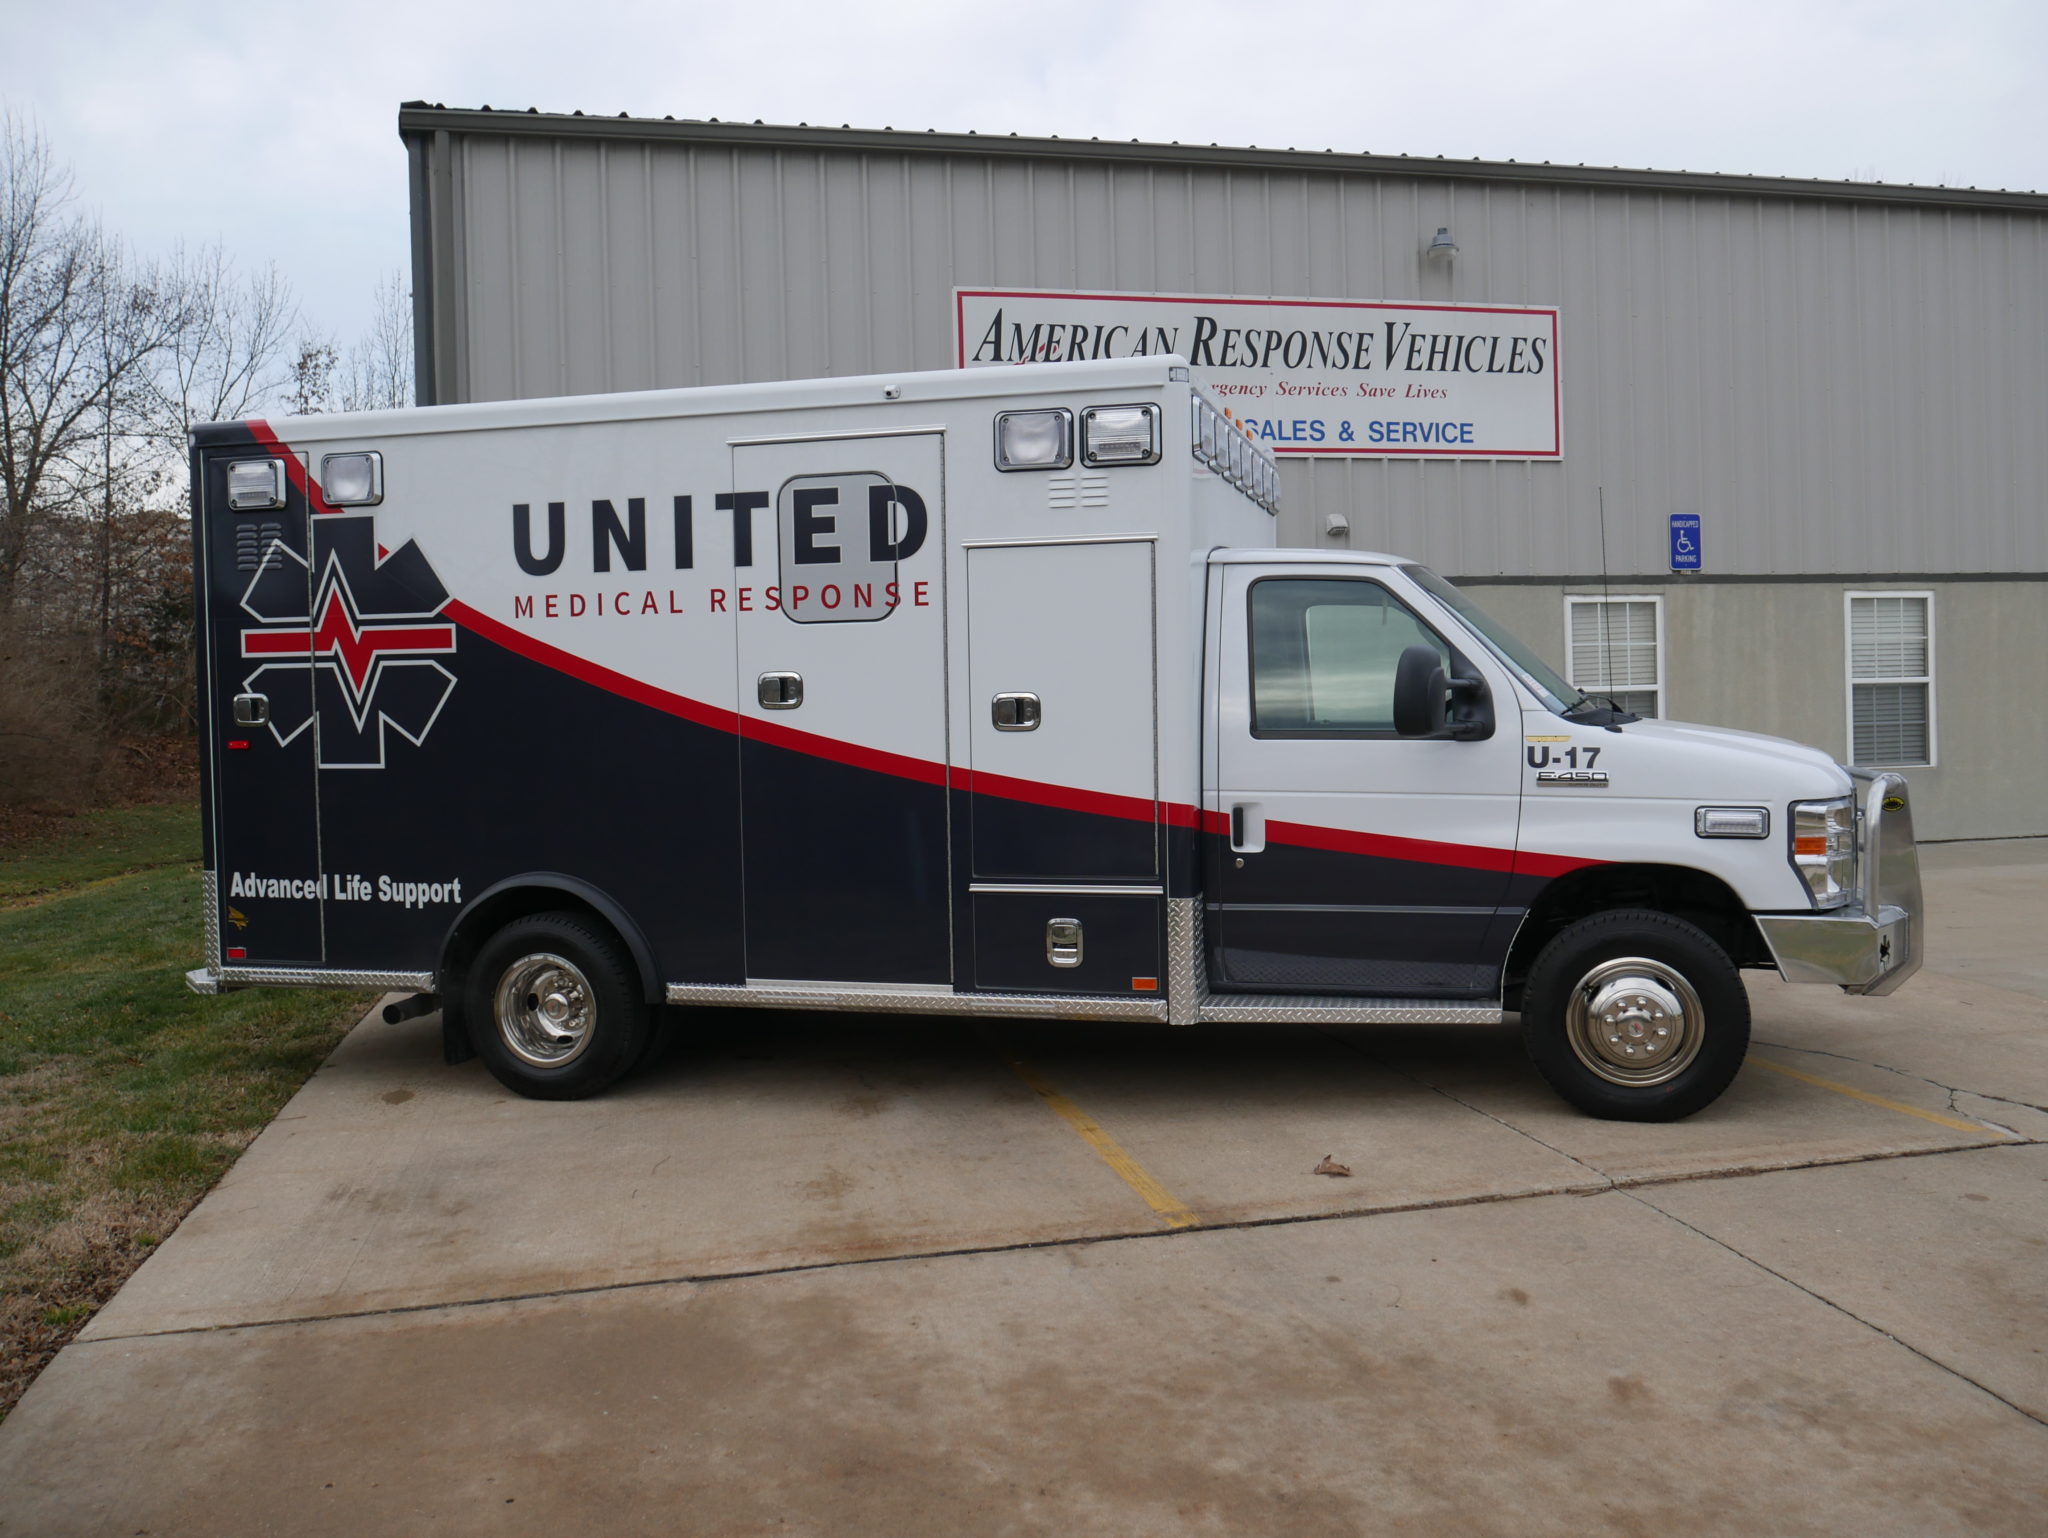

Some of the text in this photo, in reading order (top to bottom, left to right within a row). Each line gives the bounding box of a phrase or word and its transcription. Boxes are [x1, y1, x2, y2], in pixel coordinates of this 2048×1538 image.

[1190, 316, 1374, 370] RESPONSE
[1385, 321, 1547, 375] VEHICLES
[1275, 381, 1348, 397] Services
[1356, 383, 1396, 398] Save
[1405, 384, 1448, 399] Lives
[1338, 420, 1355, 441] &
[1368, 421, 1474, 443] SERVICE
[512, 484, 928, 576] UNITED
[514, 581, 929, 619] MEDICAL RESPONSE
[1527, 746, 1601, 769] U-17
[230, 871, 462, 909] Advanced Life Support
